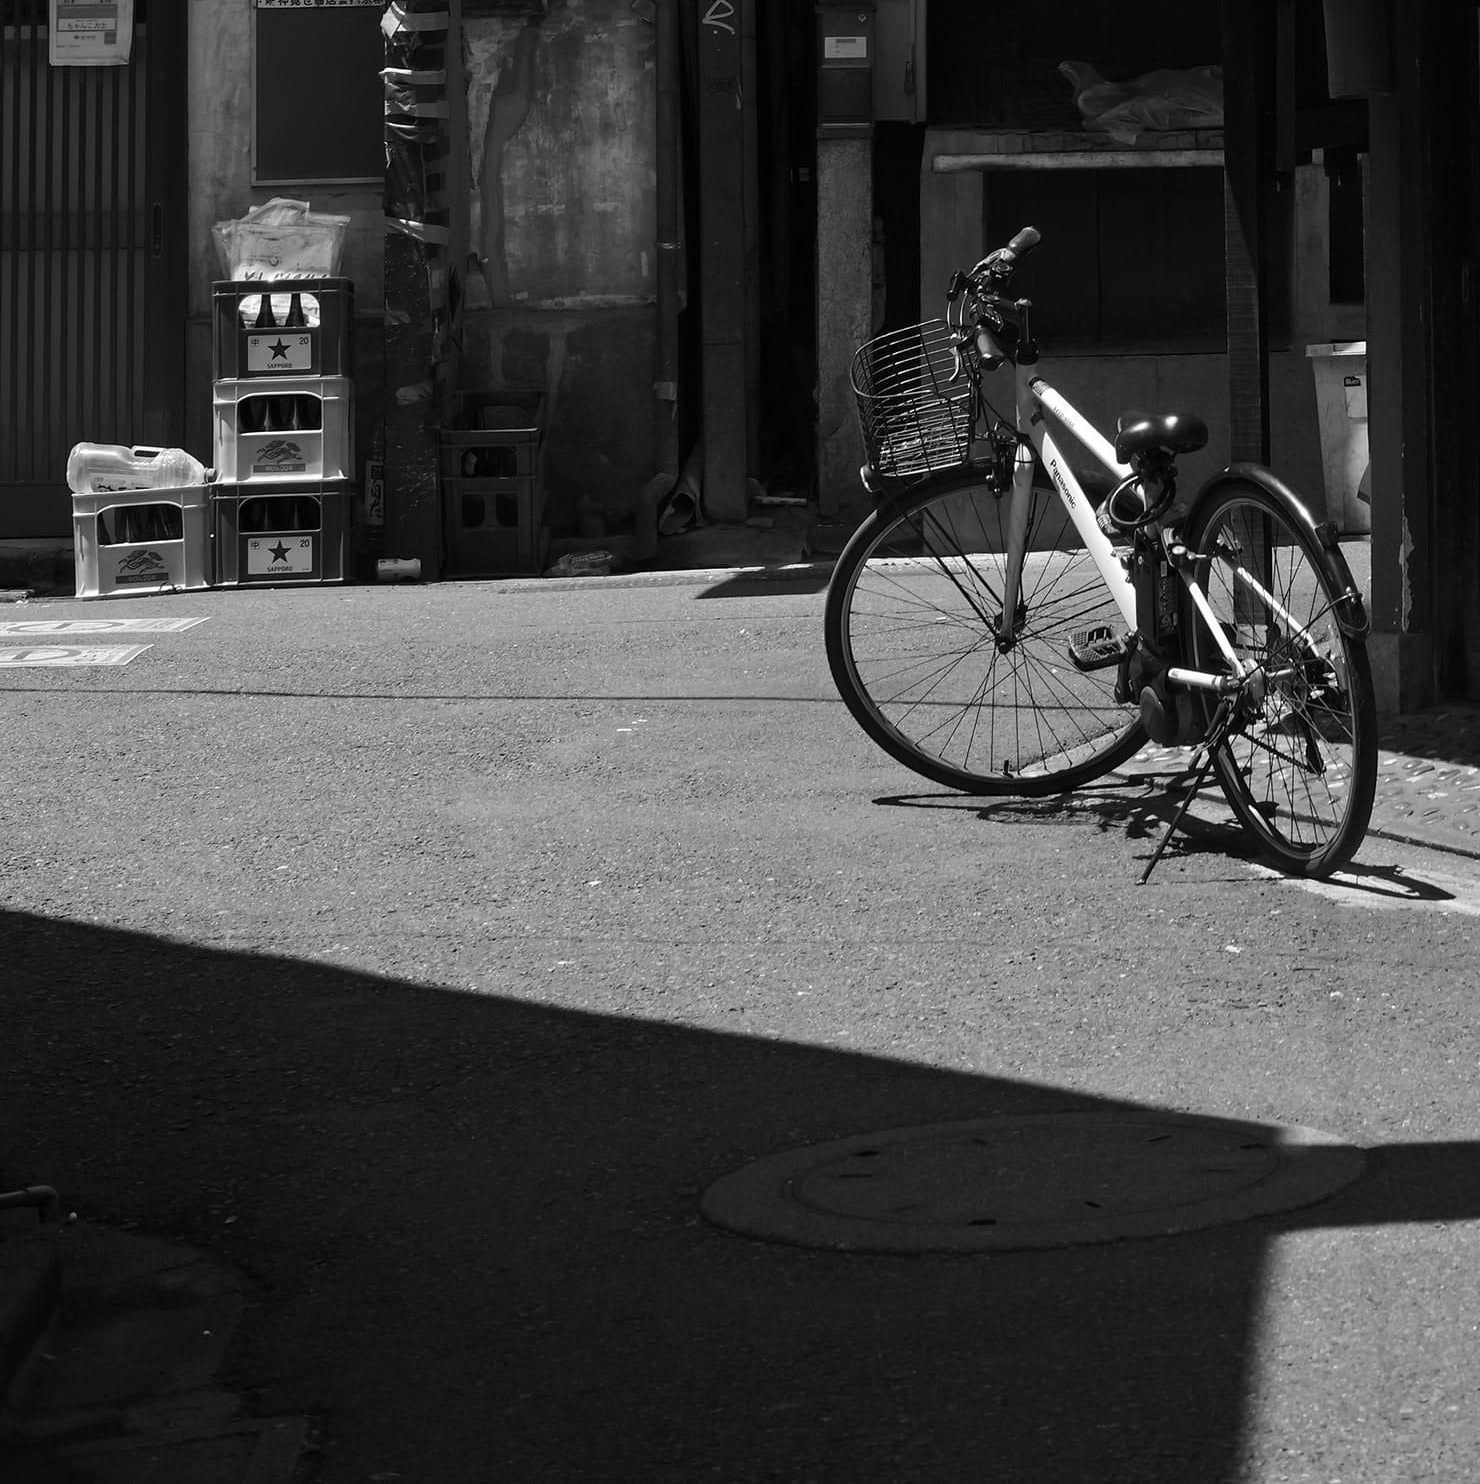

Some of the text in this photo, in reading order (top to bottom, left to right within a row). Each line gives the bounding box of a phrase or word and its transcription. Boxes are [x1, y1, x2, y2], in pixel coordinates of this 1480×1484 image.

[299, 336, 309, 345] 20
[1050, 459, 1077, 510] Panasonic
[300, 539, 310, 548] 20
